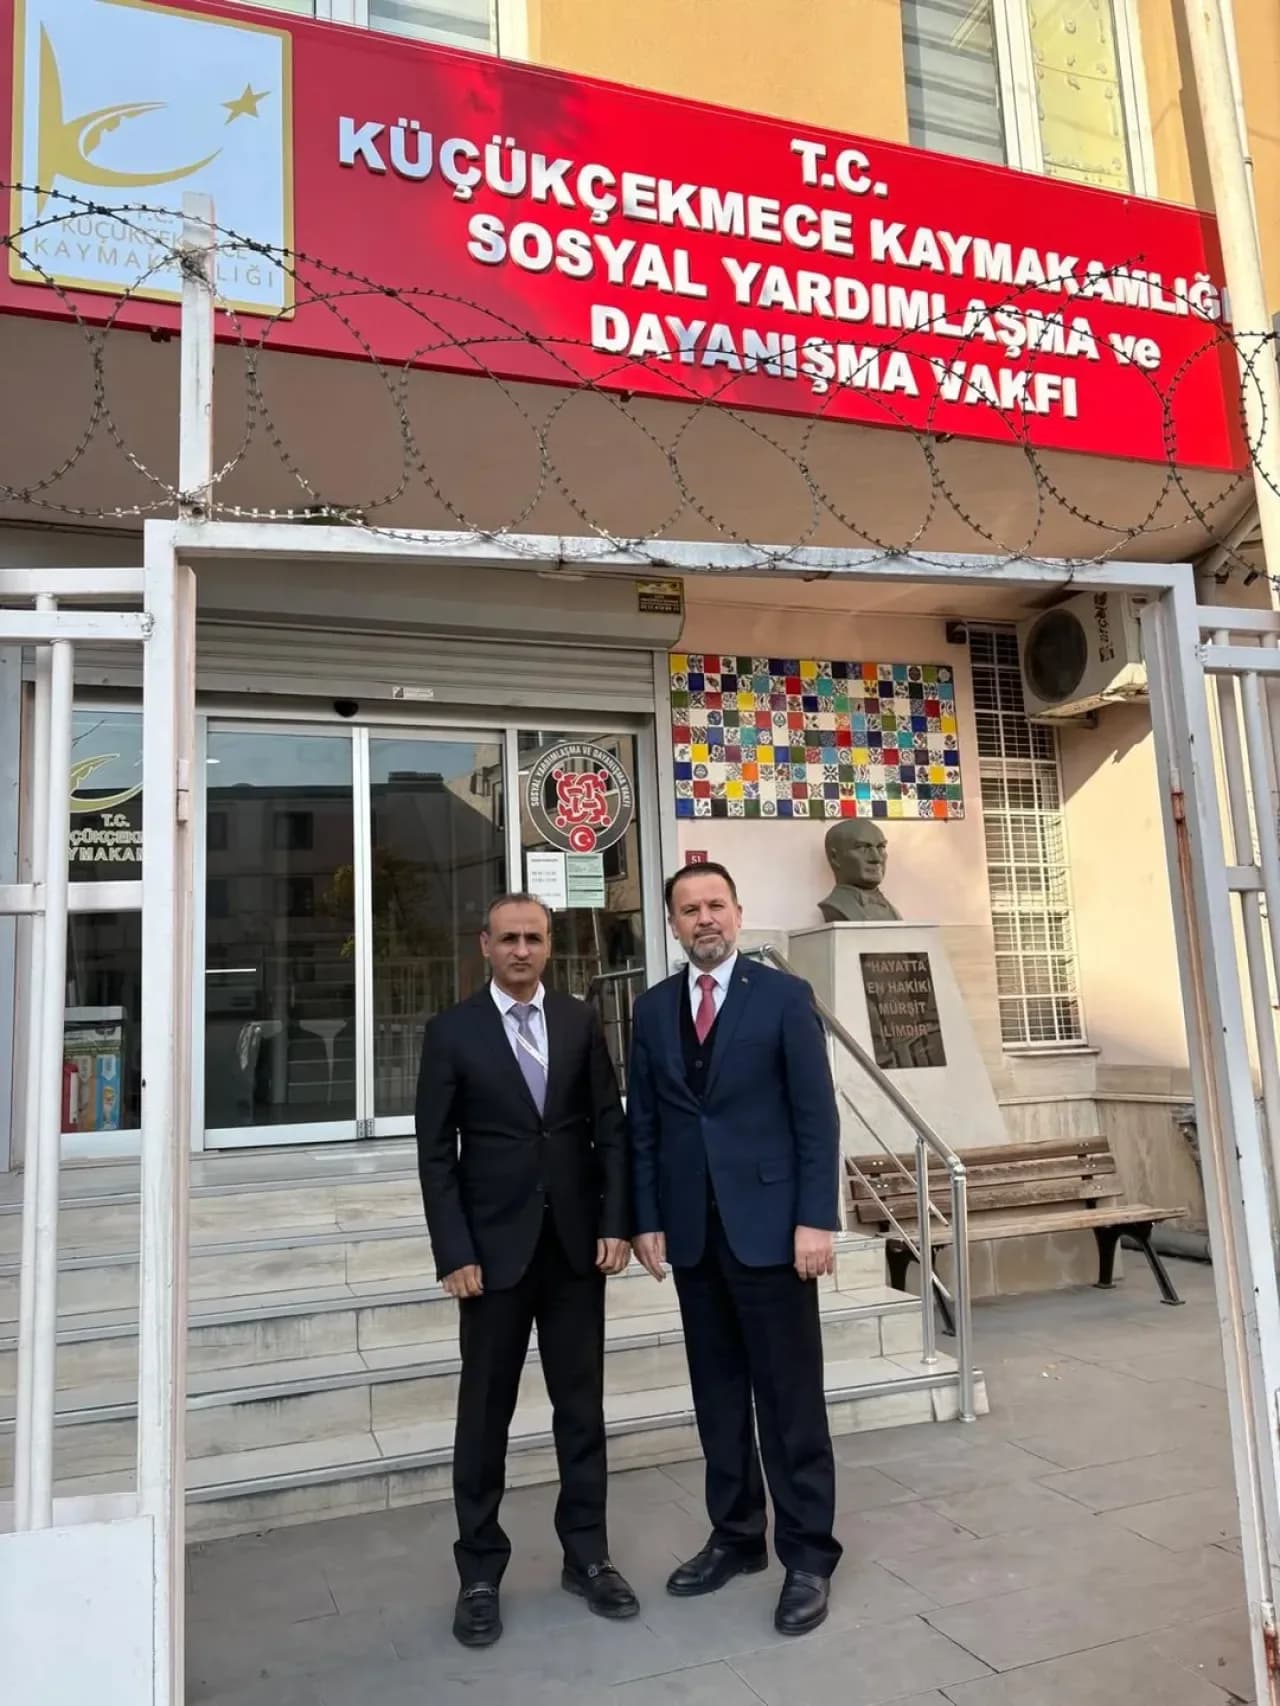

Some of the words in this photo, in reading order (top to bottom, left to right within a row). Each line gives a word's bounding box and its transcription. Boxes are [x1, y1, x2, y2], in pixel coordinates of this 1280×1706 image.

[790, 138, 888, 196] T.C.
[62, 215, 249, 260] KÜÇÜKÇEKCE
[339, 116, 854, 256] KÜÇÜKÇEKMECE
[870, 218, 1232, 325] KAYMAKAMLIĞI
[34, 237, 273, 289] KAYMAKALIĞI
[467, 213, 707, 298] SOSYAL
[721, 256, 1100, 361] YARDIMLAŞMA
[1108, 332, 1161, 369] ve
[591, 304, 920, 397] DAYANIŞMA
[930, 357, 1078, 419] VAKFI
[101, 813, 130, 827] T.C.
